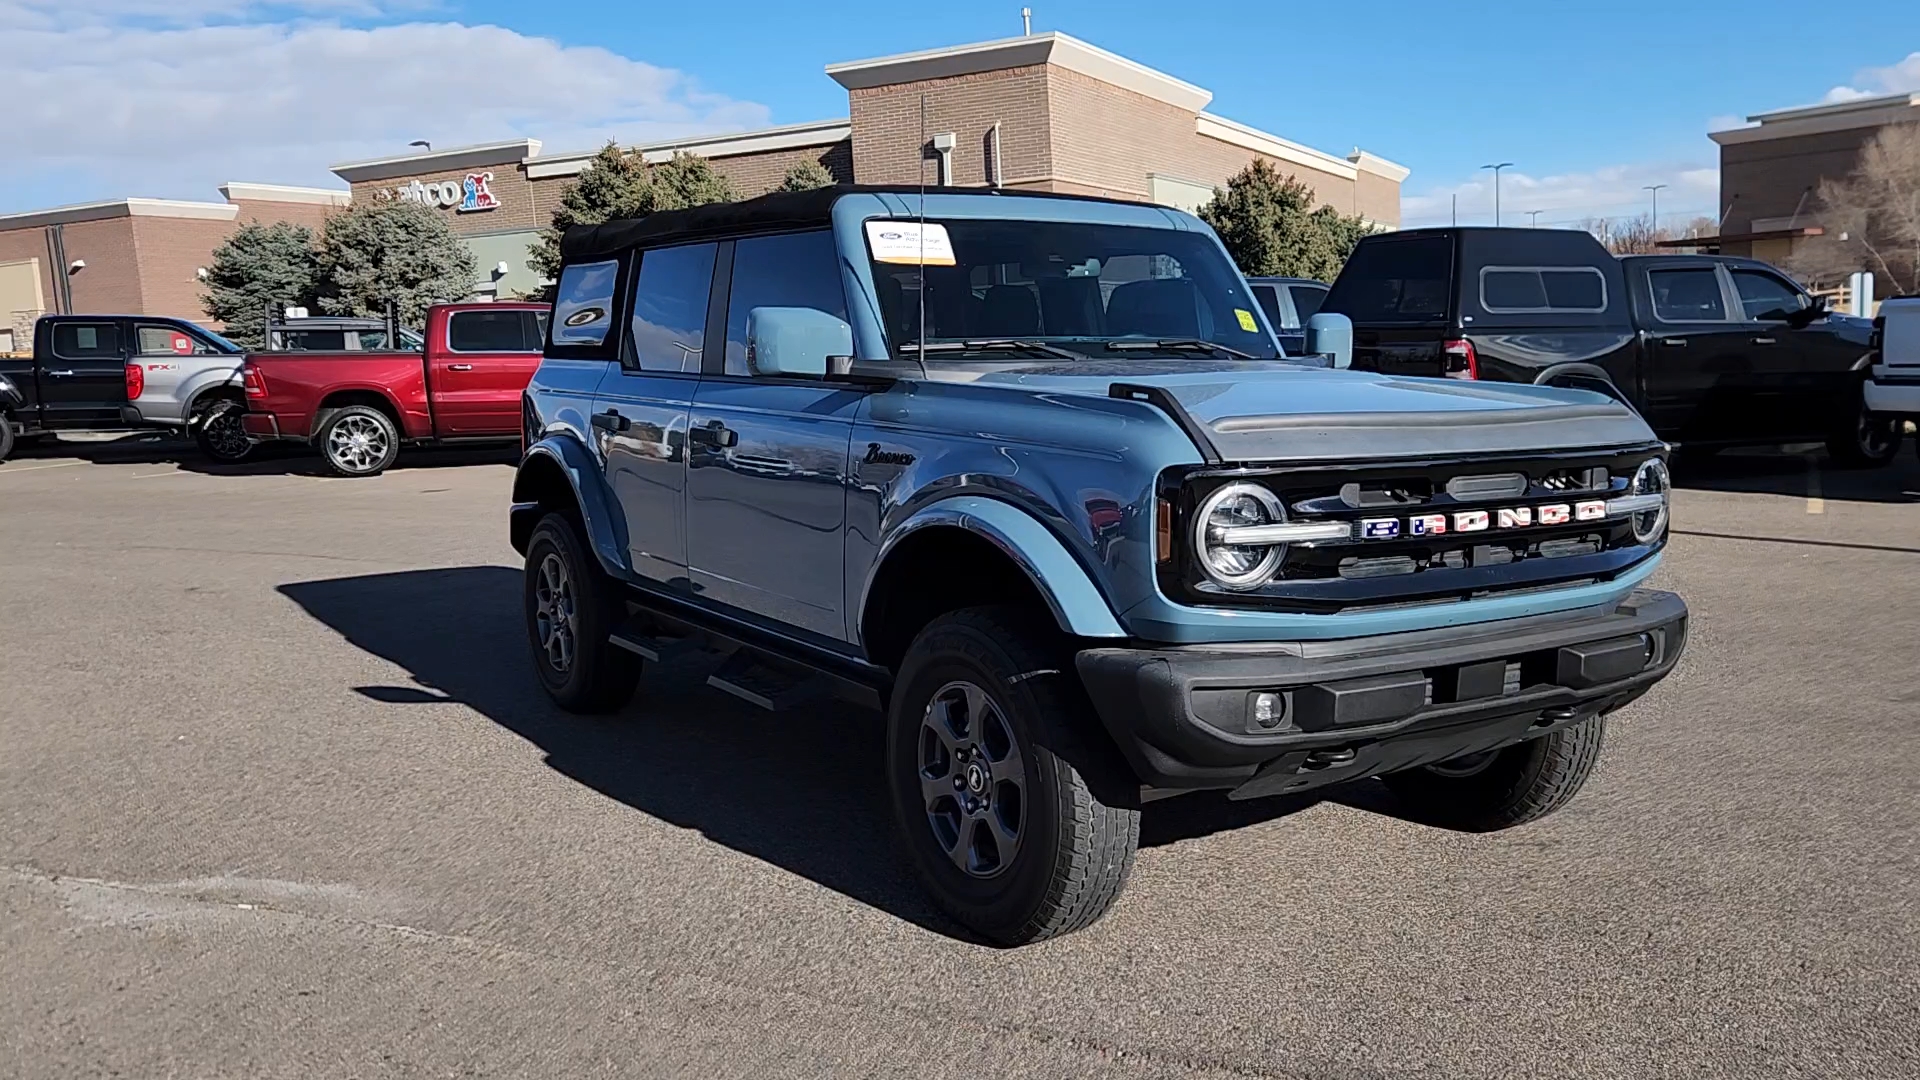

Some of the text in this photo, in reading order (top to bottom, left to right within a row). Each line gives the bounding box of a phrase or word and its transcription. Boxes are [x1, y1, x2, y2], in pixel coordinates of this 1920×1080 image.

[371, 180, 461, 207] etco
[147, 363, 180, 371] FX4
[862, 442, 917, 466] Bronco
[1361, 499, 1607, 540] BRONCO
